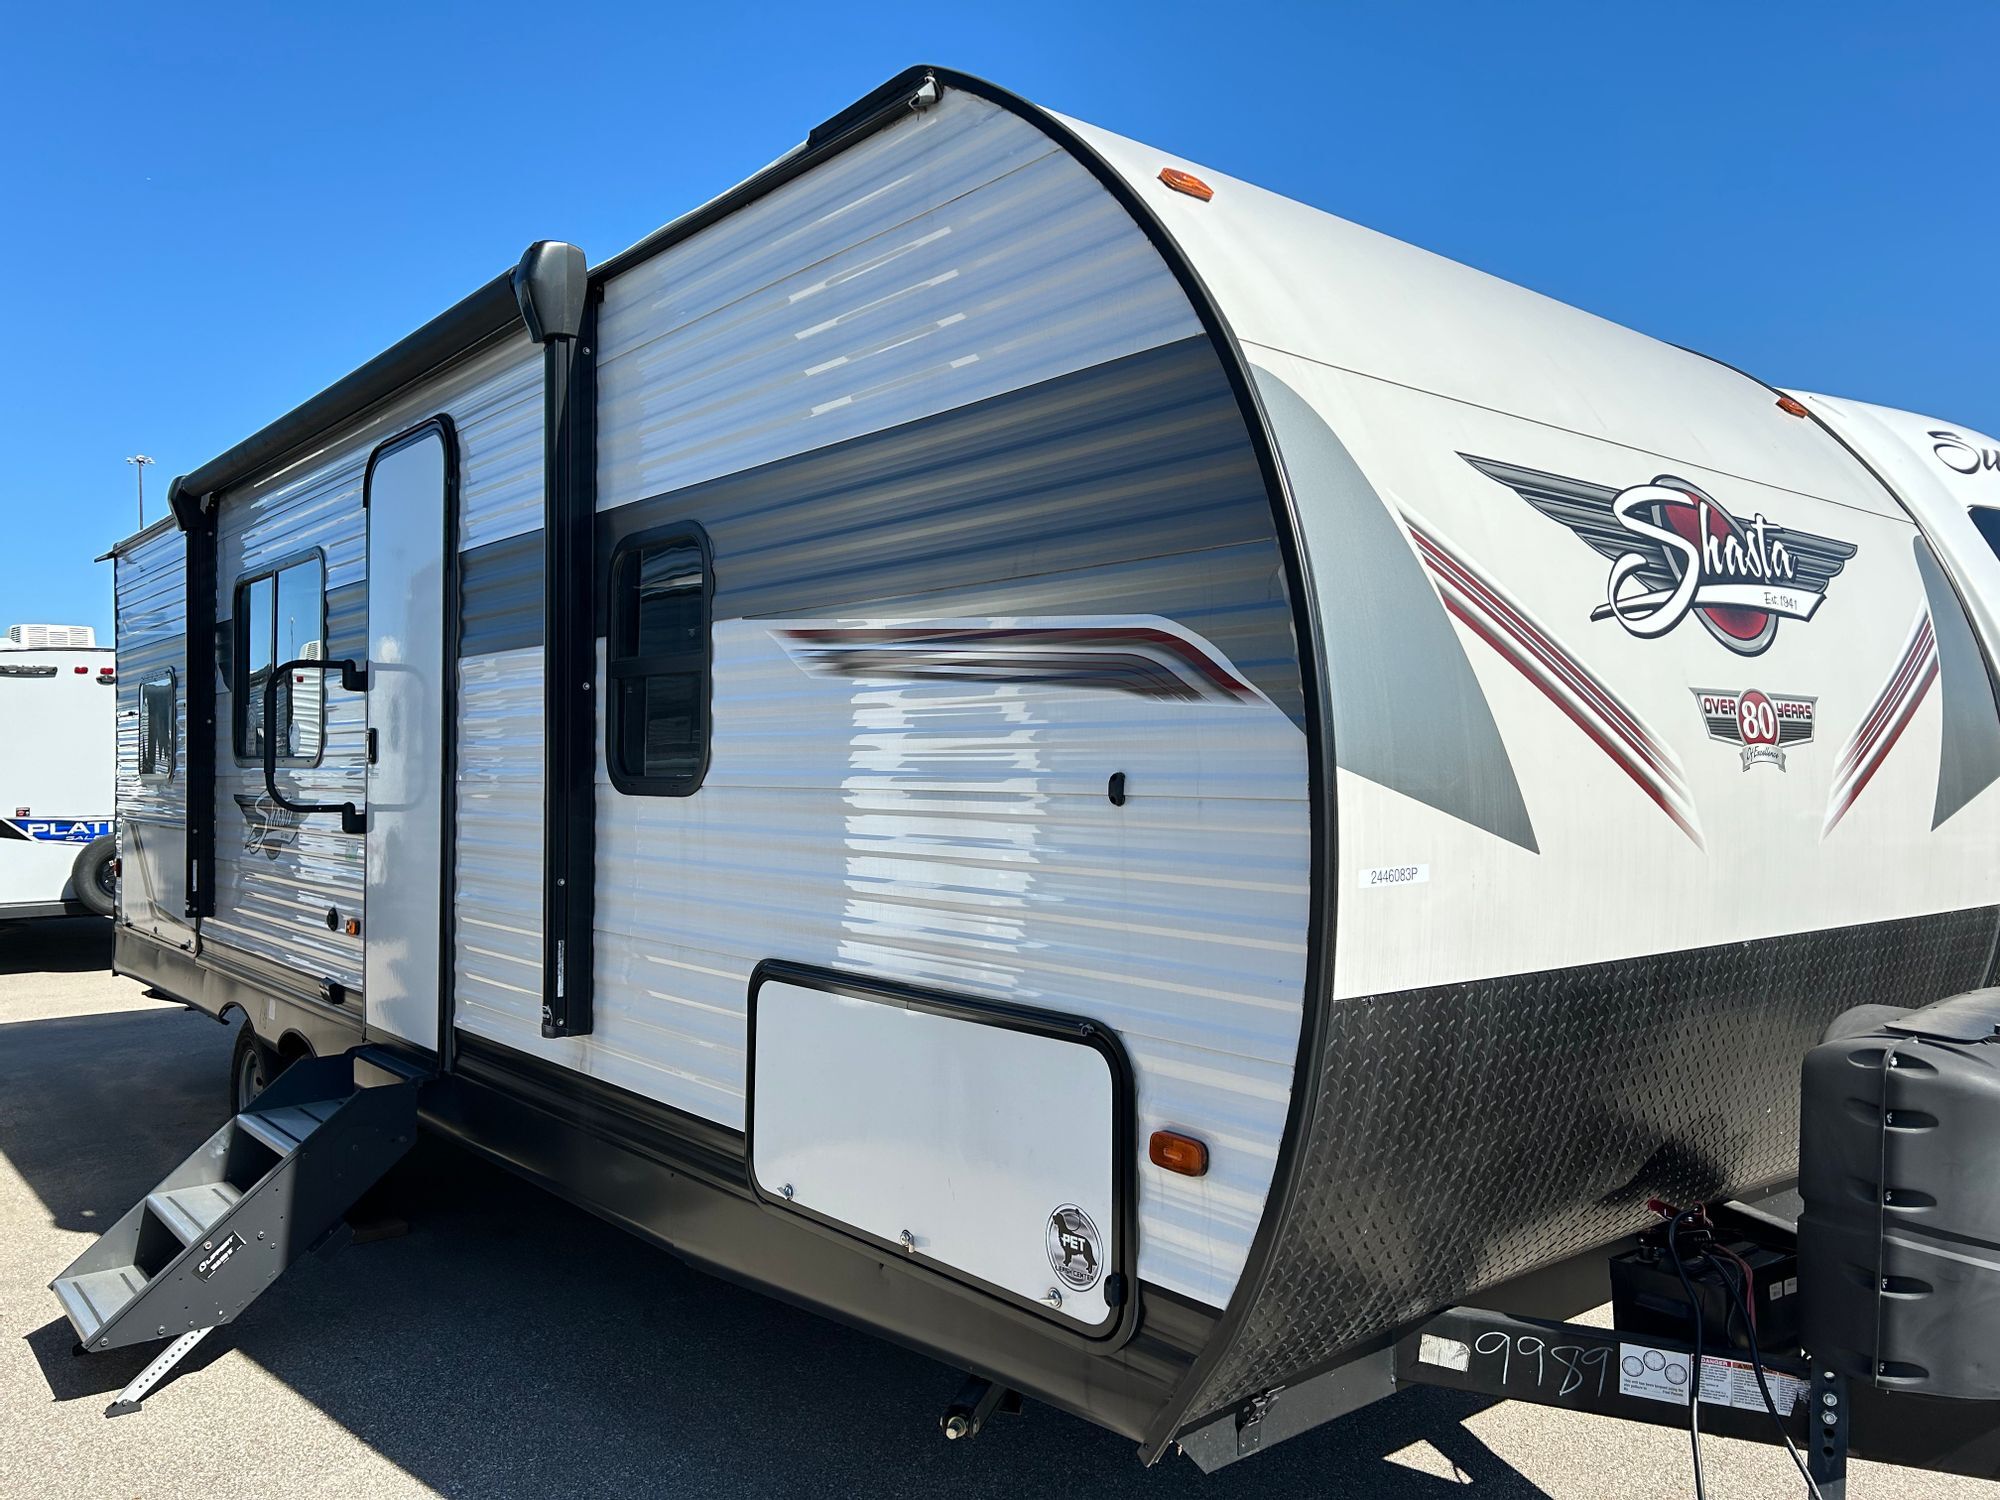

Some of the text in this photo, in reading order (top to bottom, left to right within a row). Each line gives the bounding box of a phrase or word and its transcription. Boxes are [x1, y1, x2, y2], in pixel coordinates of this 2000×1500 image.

[1607, 484, 1799, 639] Shasta
[1703, 697, 1813, 740] OVER 80 YEARS
[1370, 866, 1419, 885] 2446083P
[1060, 1233, 1086, 1252] PET
[1073, 1270, 1095, 1282] CENTER
[1475, 1331, 1614, 1398] 9989
[1701, 1357, 1729, 1368] DANGER
